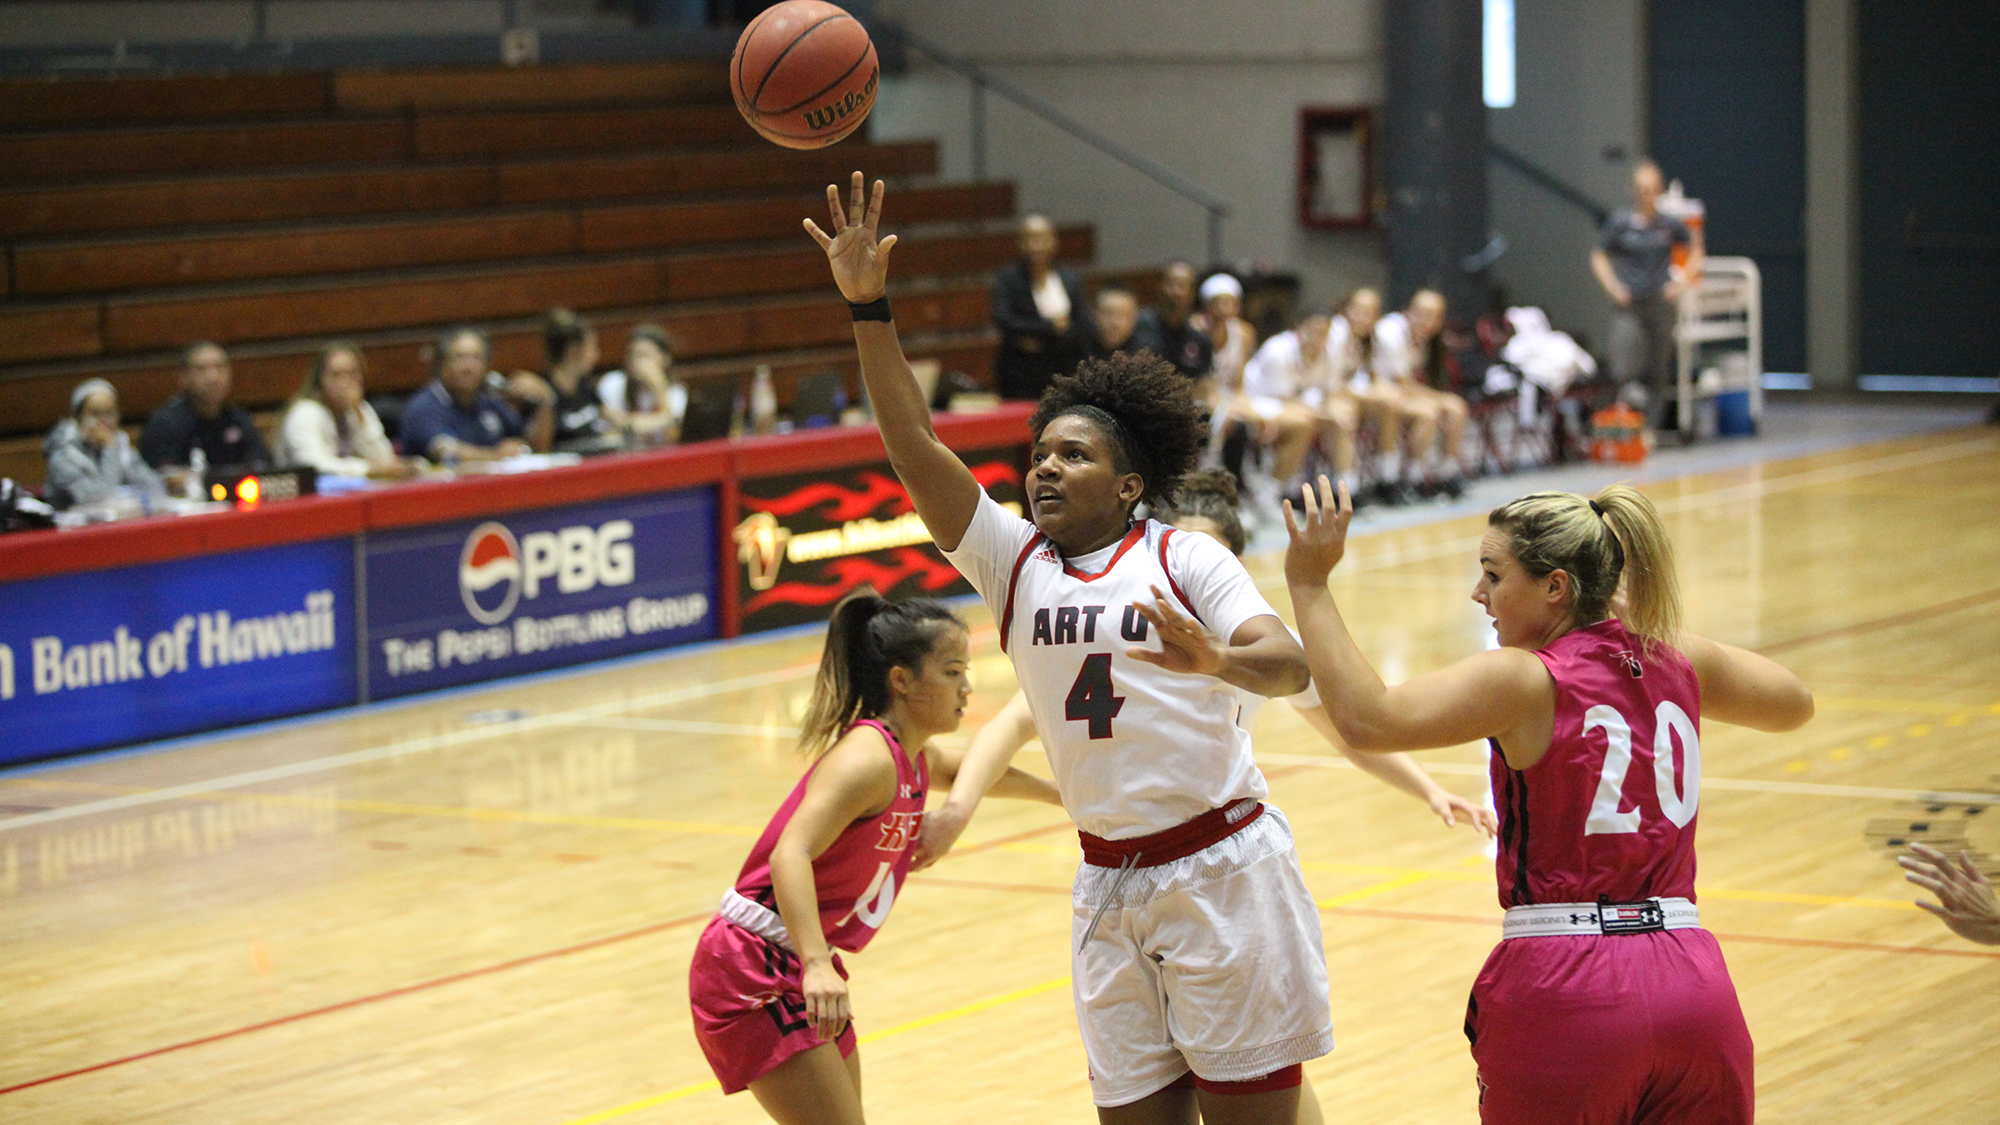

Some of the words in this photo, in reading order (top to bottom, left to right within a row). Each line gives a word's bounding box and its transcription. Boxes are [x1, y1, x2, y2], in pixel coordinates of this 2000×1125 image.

[802, 66, 878, 131] Wilson
[521, 519, 635, 599] PBG
[1033, 555, 1058, 564] adidas
[32, 625, 144, 695] Bank
[147, 614, 197, 678] of
[384, 638, 434, 676] THE
[437, 628, 512, 668] PEPSI
[513, 606, 626, 654] BOTTLING
[627, 592, 708, 635] GROUP
[1032, 605, 1106, 646] ART
[1121, 604, 1151, 642] U
[1065, 653, 1126, 740] 4
[1582, 700, 1700, 836] 20
